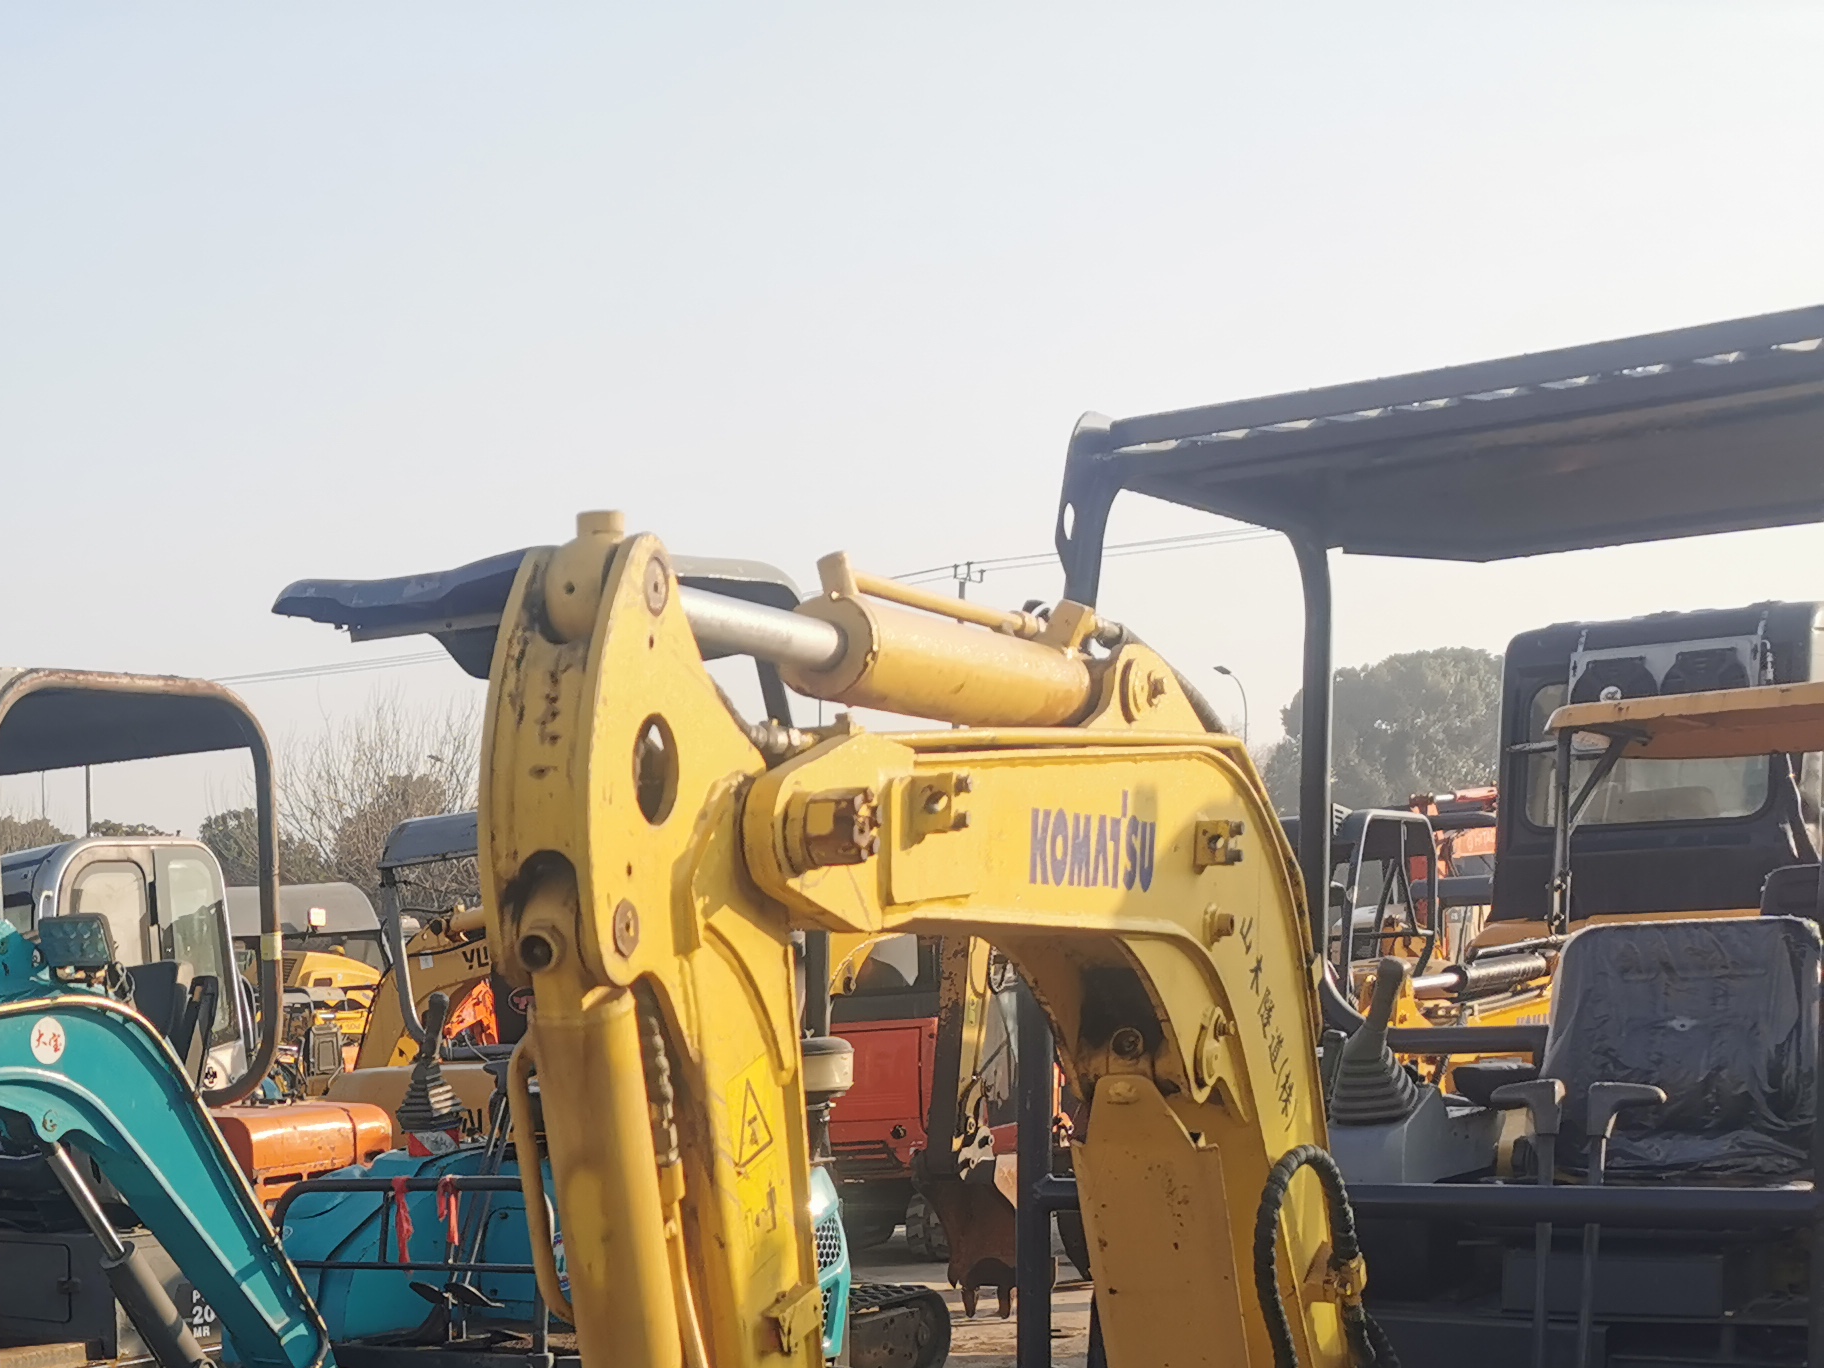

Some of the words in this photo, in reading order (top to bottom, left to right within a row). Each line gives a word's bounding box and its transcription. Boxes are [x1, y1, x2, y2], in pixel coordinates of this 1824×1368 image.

[1029, 789, 1157, 893] KOMATSU
[192, 1305, 216, 1324] 20
[193, 1325, 211, 1338] MR
